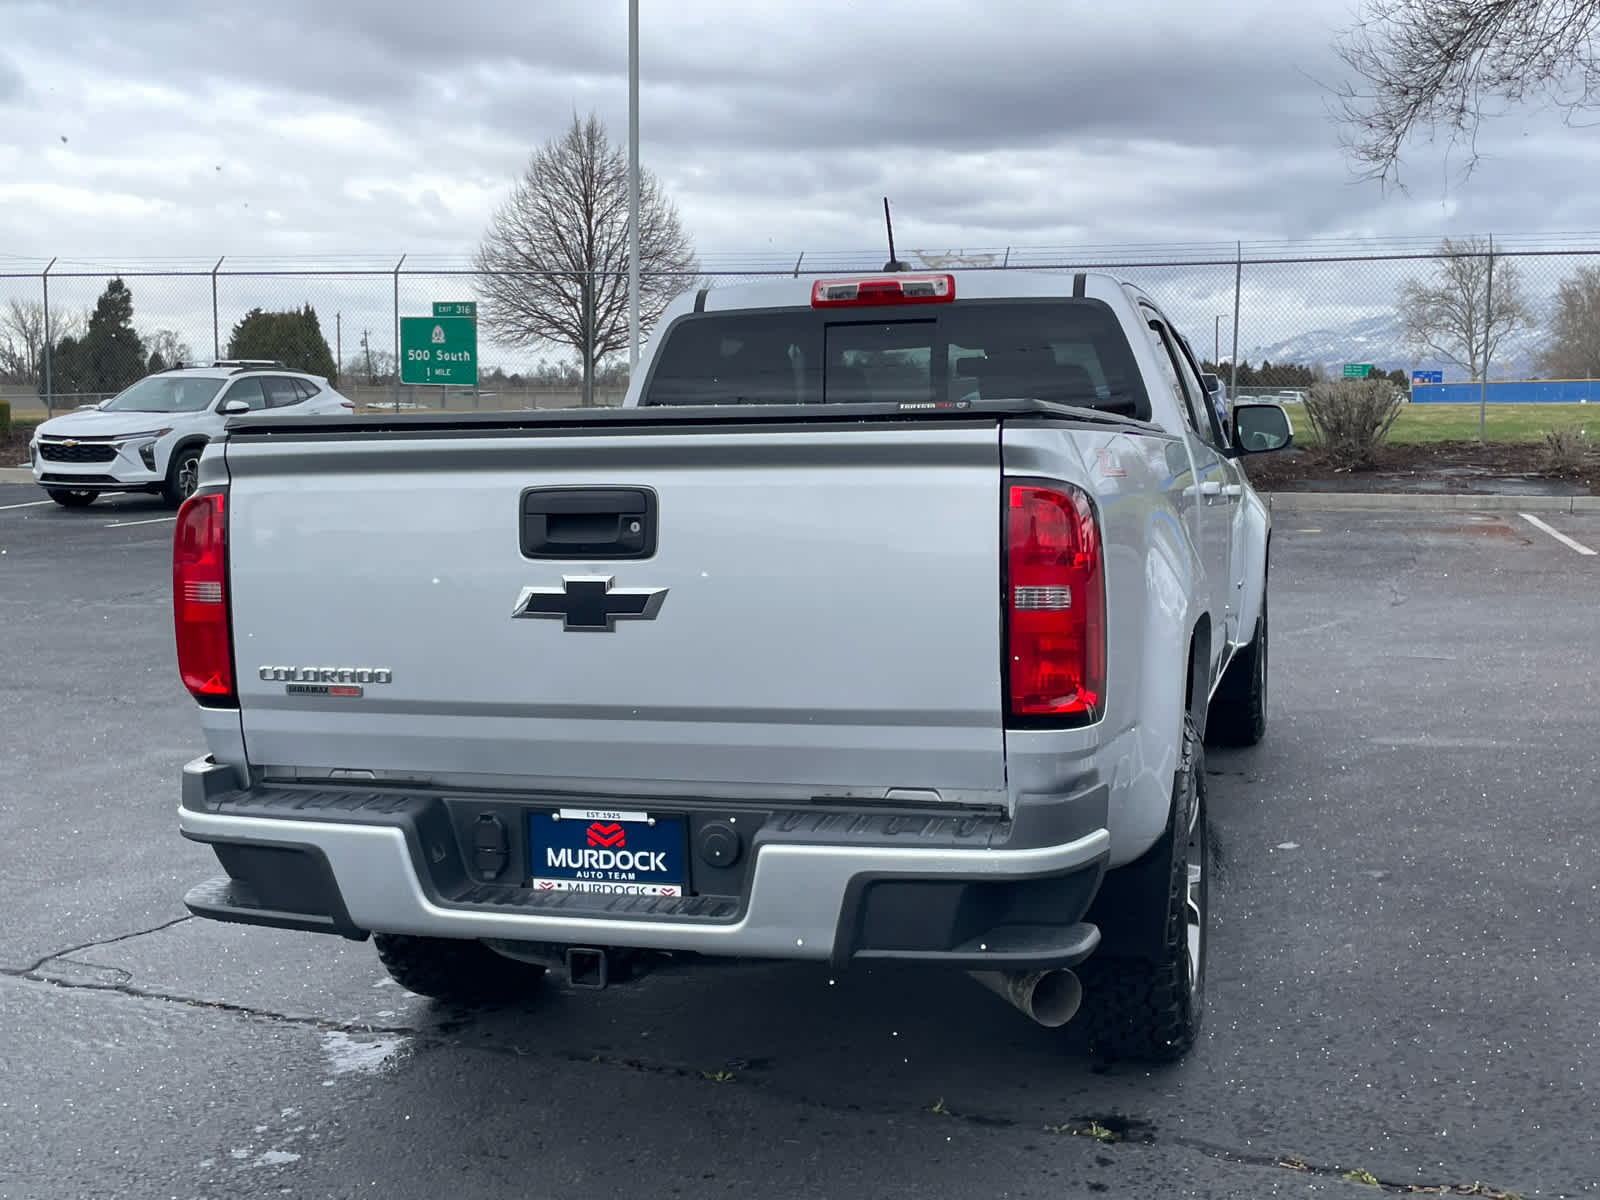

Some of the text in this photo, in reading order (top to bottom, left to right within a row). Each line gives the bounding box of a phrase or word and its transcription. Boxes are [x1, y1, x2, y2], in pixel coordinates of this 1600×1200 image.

[455, 305, 471, 314] 316
[407, 349, 471, 361] 500 South
[434, 368, 451, 376] MILE
[259, 665, 392, 684] COLORADO
[547, 847, 668, 872] MURDOCK
[576, 871, 636, 880] AUTO TEAM
[567, 882, 648, 896] MURDOCK
